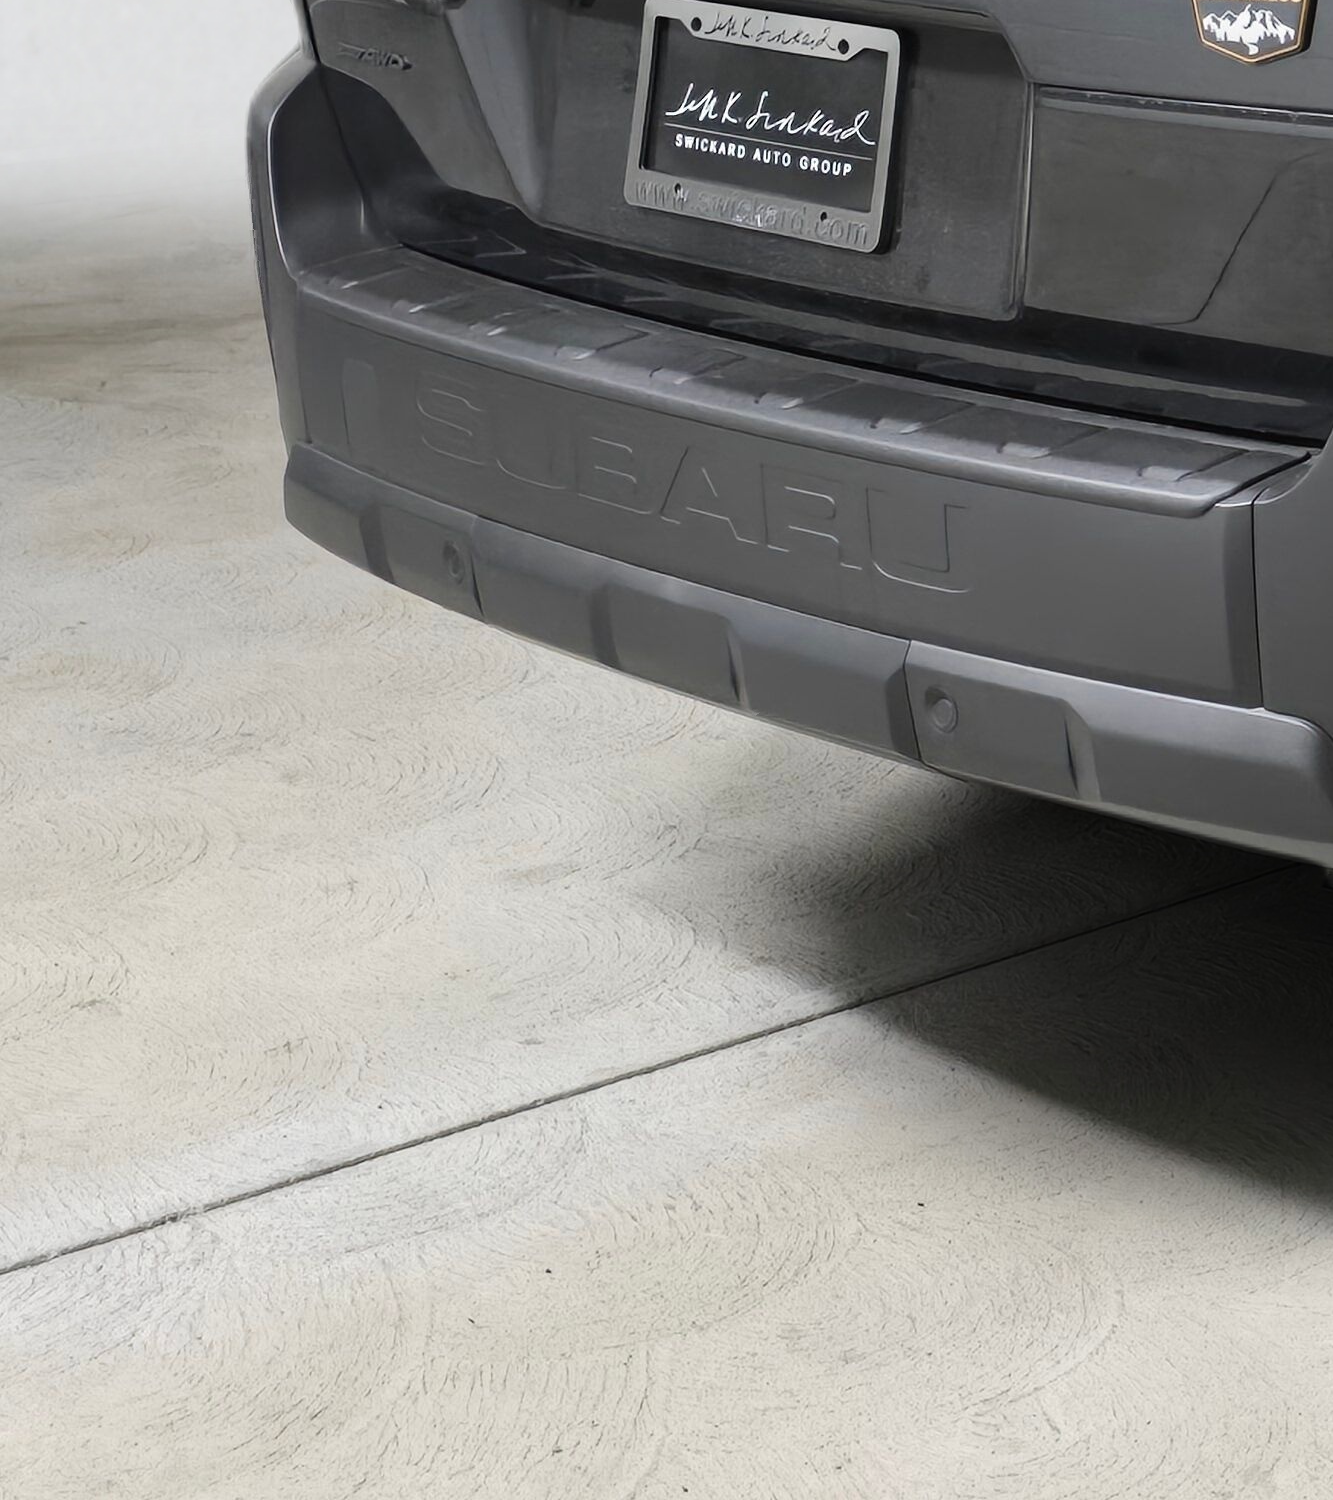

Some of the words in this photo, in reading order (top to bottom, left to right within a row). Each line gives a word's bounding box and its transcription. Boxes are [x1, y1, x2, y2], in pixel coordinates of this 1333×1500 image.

[674, 133, 746, 159] SWICKARD
[752, 148, 792, 167] AUTO
[799, 155, 853, 177] GROUP
[414, 371, 974, 595] SUBARU
